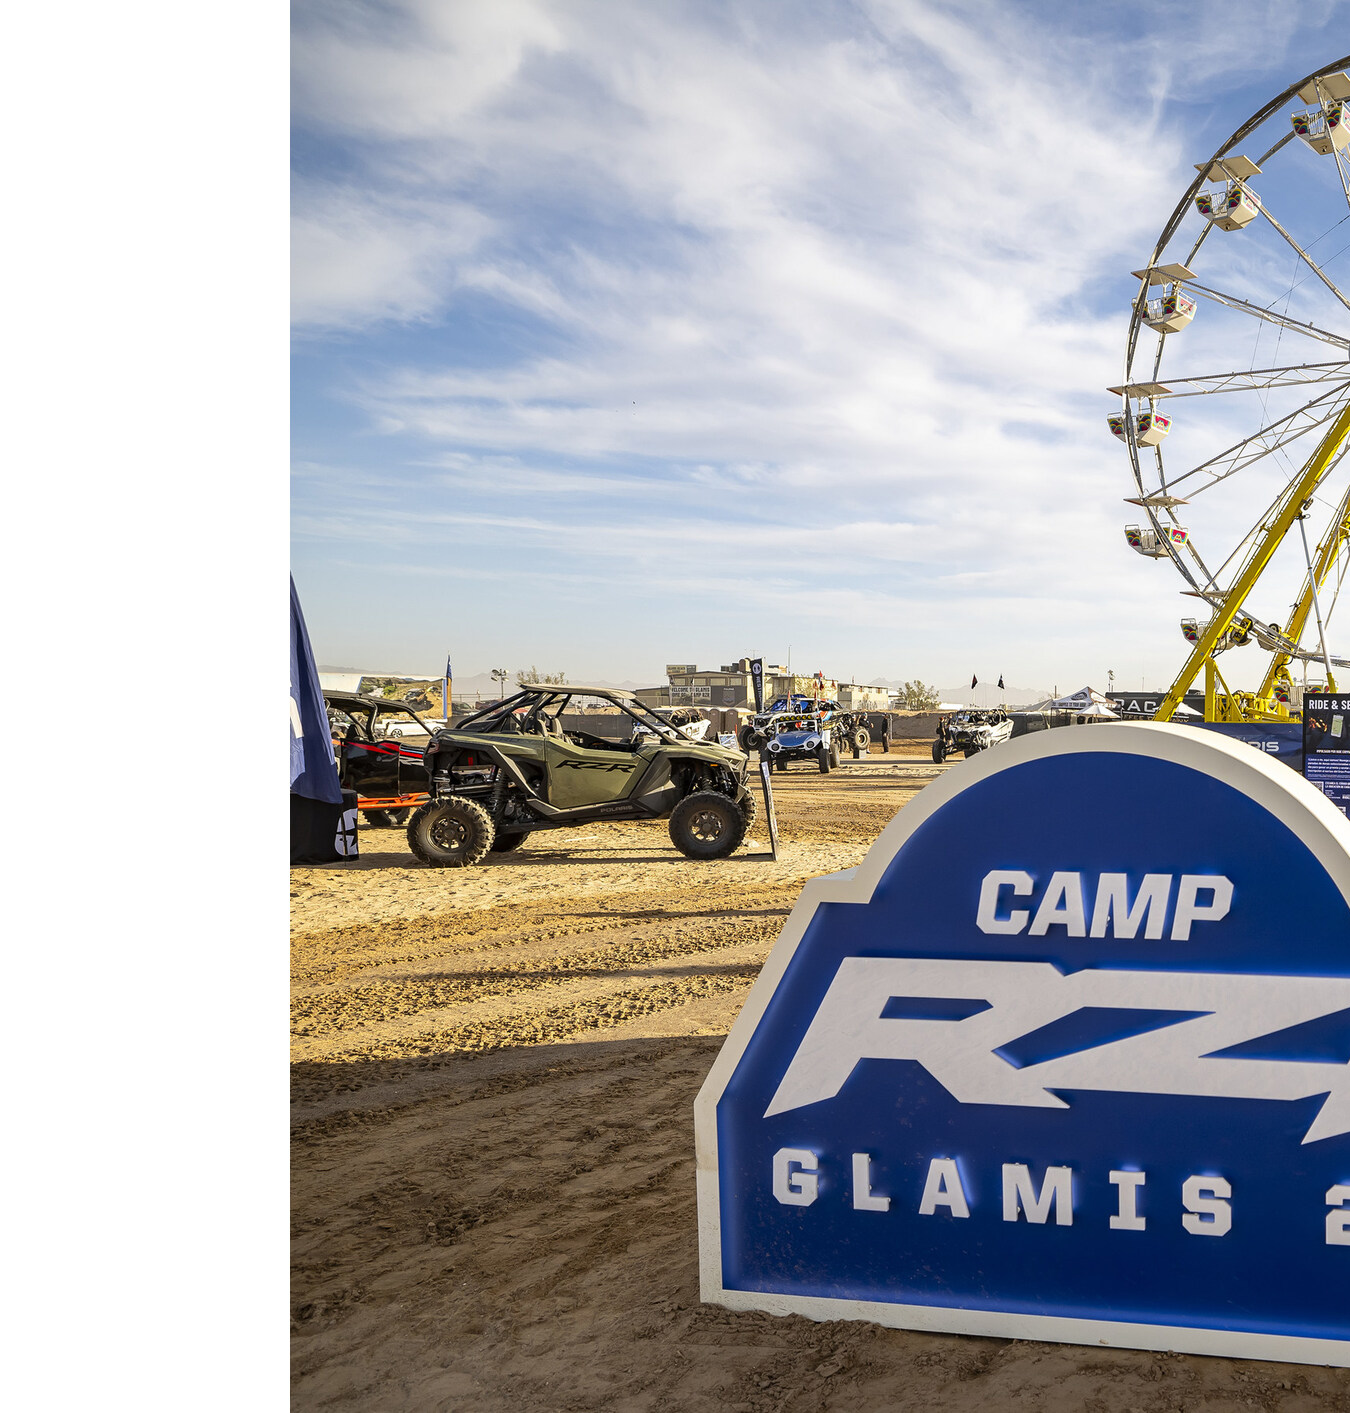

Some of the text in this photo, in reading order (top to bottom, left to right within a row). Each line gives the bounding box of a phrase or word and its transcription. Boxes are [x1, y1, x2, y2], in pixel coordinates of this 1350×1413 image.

[1309, 700, 1329, 710] RIDE
[1331, 700, 1339, 710] &
[555, 760, 637, 773] RZR
[976, 870, 1234, 941] CAMP
[773, 1147, 1232, 1237] GLAMIS
